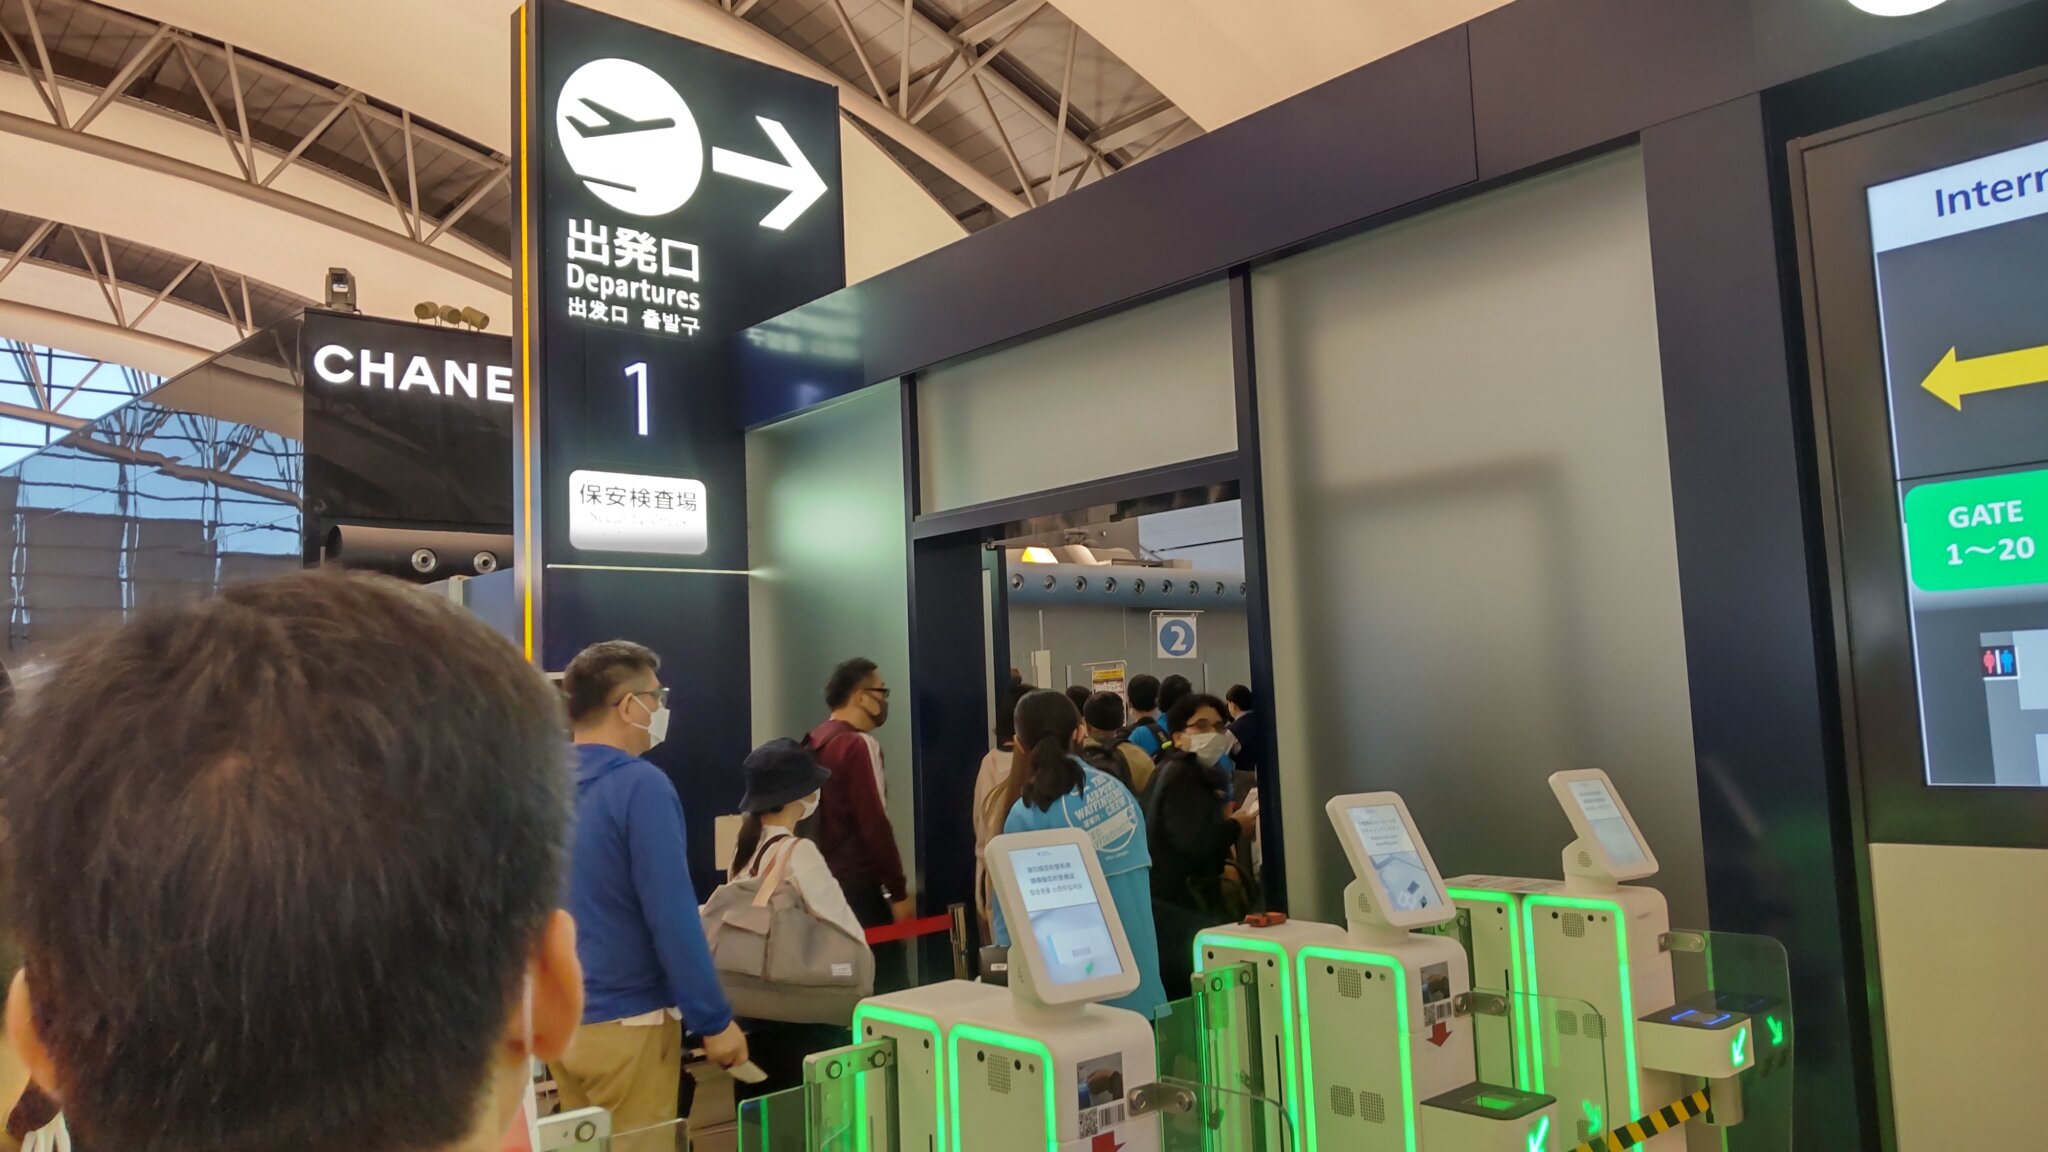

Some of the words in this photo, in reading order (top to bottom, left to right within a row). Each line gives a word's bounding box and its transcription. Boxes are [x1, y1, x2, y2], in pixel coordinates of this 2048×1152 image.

[567, 218, 700, 282] 出発口
[567, 262, 700, 310] Departures
[568, 296, 628, 324] 出发口
[642, 308, 700, 336] 출발구
[313, 344, 514, 403] CHANE
[624, 361, 649, 436] 1
[579, 483, 698, 512] 保安検査場
[1948, 499, 2024, 528] GATE
[1170, 625, 1187, 651] 2
